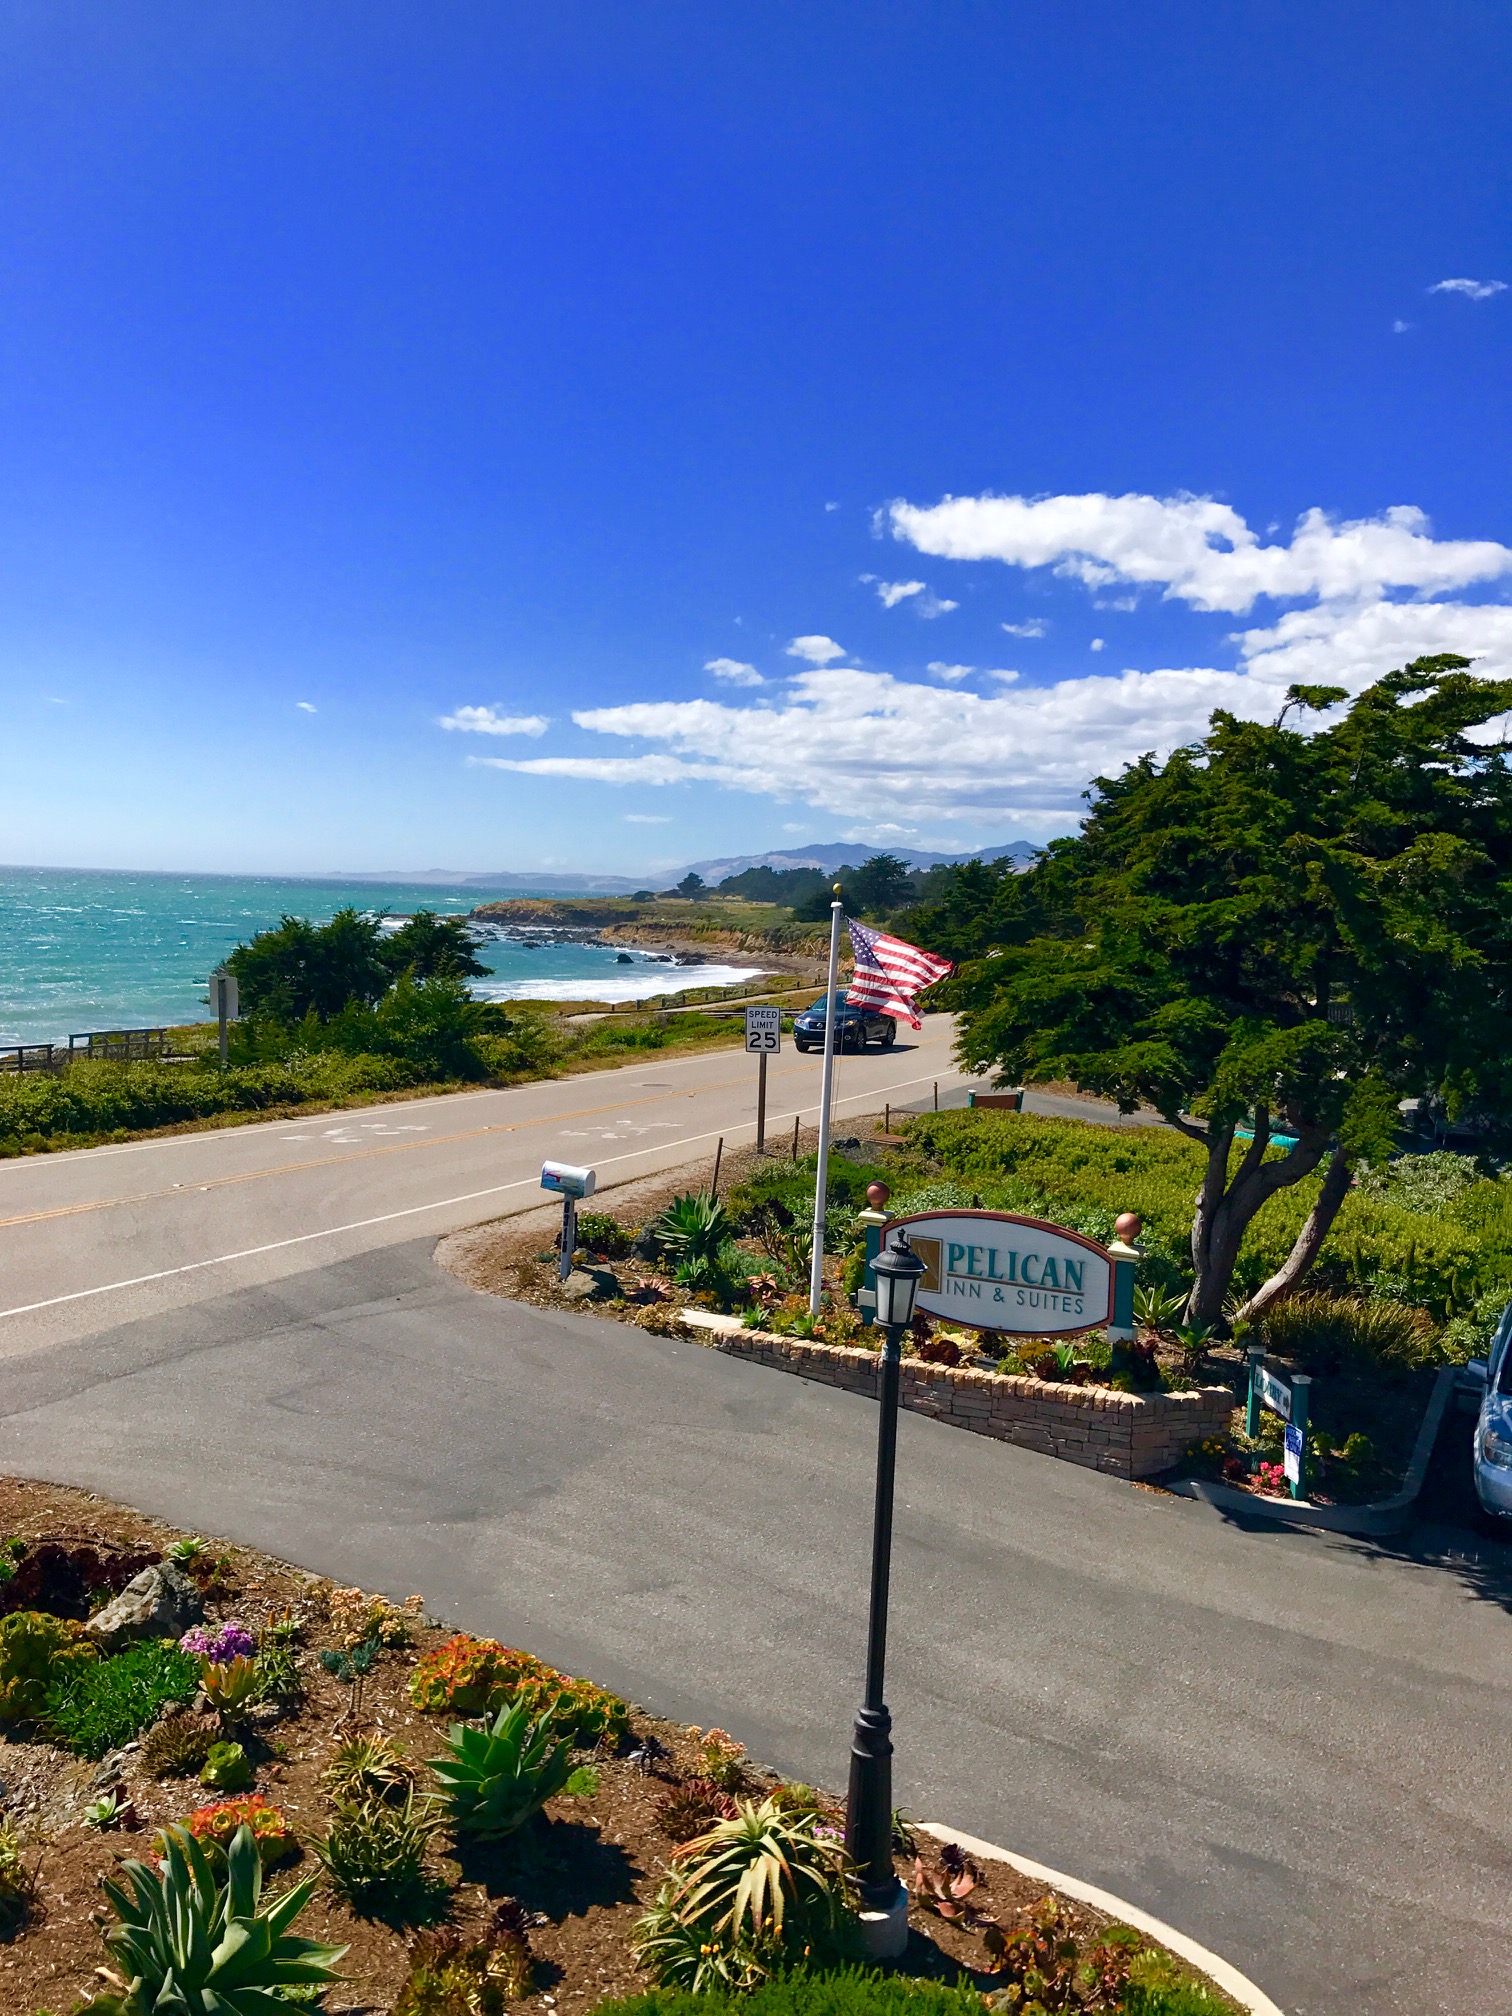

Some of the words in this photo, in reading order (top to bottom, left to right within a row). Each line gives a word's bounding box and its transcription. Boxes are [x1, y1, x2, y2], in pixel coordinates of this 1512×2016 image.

[749, 1010, 778, 1019] SPEED
[751, 1021, 774, 1029] LIMIT
[749, 1031, 777, 1049] 25
[946, 1242, 1085, 1291] PELICAN
[946, 1278, 982, 1299] INN
[993, 1286, 1006, 1303] &
[1016, 1288, 1084, 1315] SUITES
